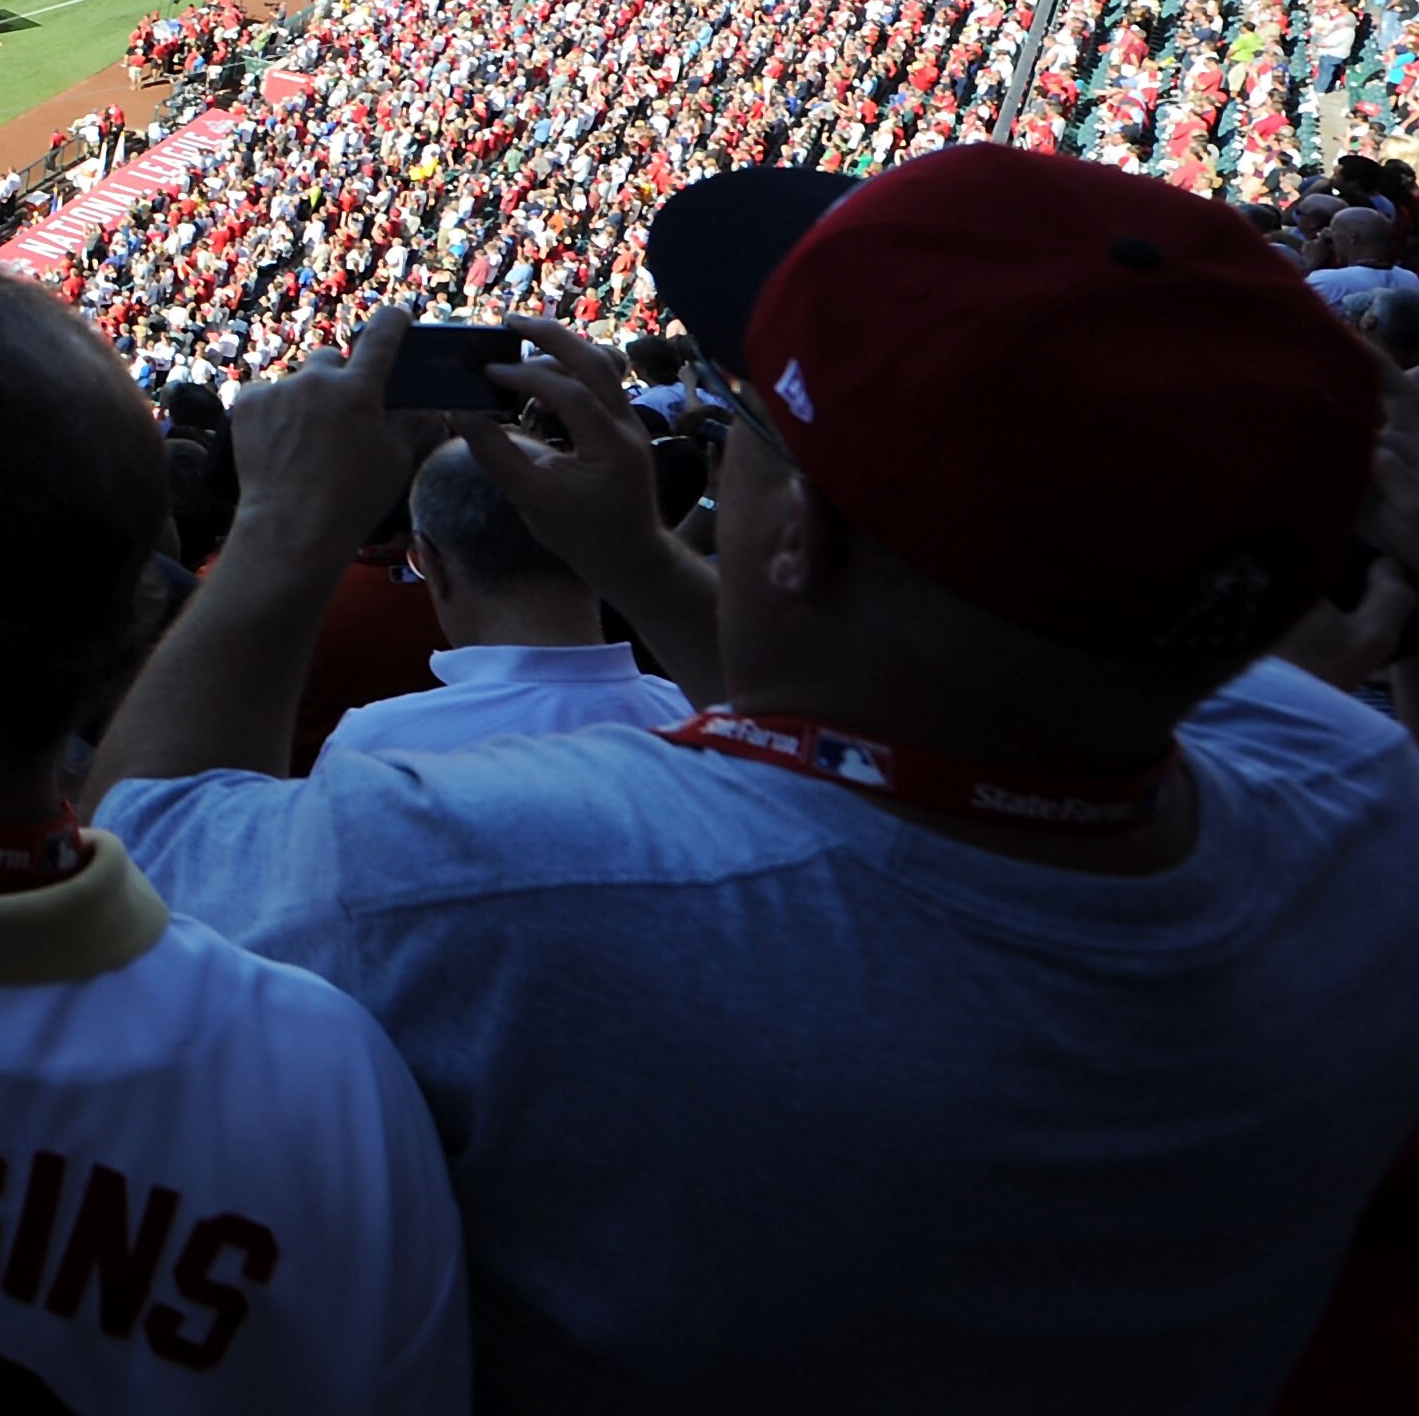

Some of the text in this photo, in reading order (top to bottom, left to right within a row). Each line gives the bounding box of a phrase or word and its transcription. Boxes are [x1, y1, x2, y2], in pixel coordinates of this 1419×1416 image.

[18, 131, 221, 260] NATIONAL LEAGUE
[739, 719, 800, 756] Farm
[968, 781, 1064, 820] State
